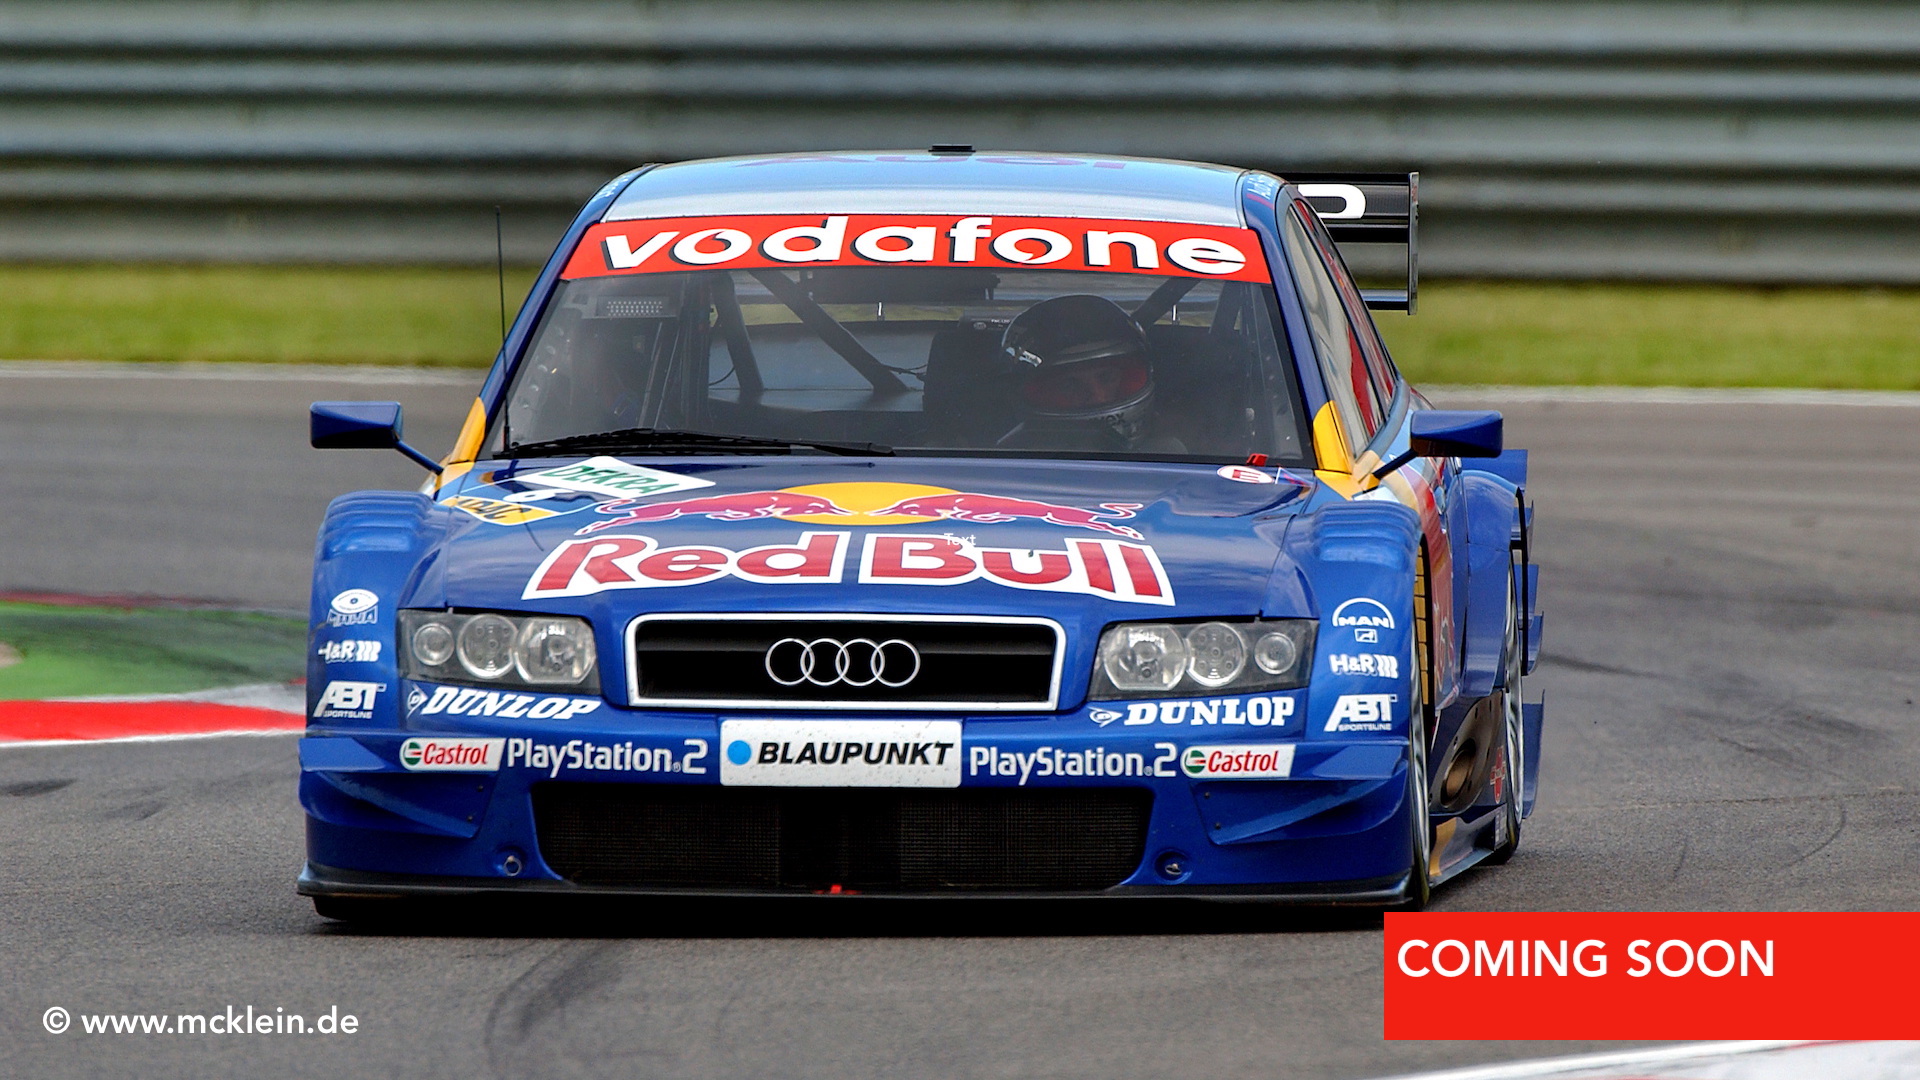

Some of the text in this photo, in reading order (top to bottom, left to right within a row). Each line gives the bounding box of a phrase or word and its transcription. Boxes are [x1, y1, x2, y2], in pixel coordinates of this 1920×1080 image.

[601, 215, 1247, 275] vodafone
[540, 464, 681, 495] DEKRA
[533, 533, 1165, 599] Red Bull
[1338, 615, 1390, 629] MAN
[1328, 653, 1376, 676] H&R
[313, 680, 379, 718] ABT
[420, 686, 602, 720] DUNLOP
[1123, 696, 1295, 727] DUNLOP
[1323, 693, 1393, 732] ABT
[1337, 722, 1393, 732] SPORTSLINE
[421, 742, 490, 765] Castrol
[757, 741, 955, 766] BLAUPUNKT
[1207, 749, 1279, 774] Castrol
